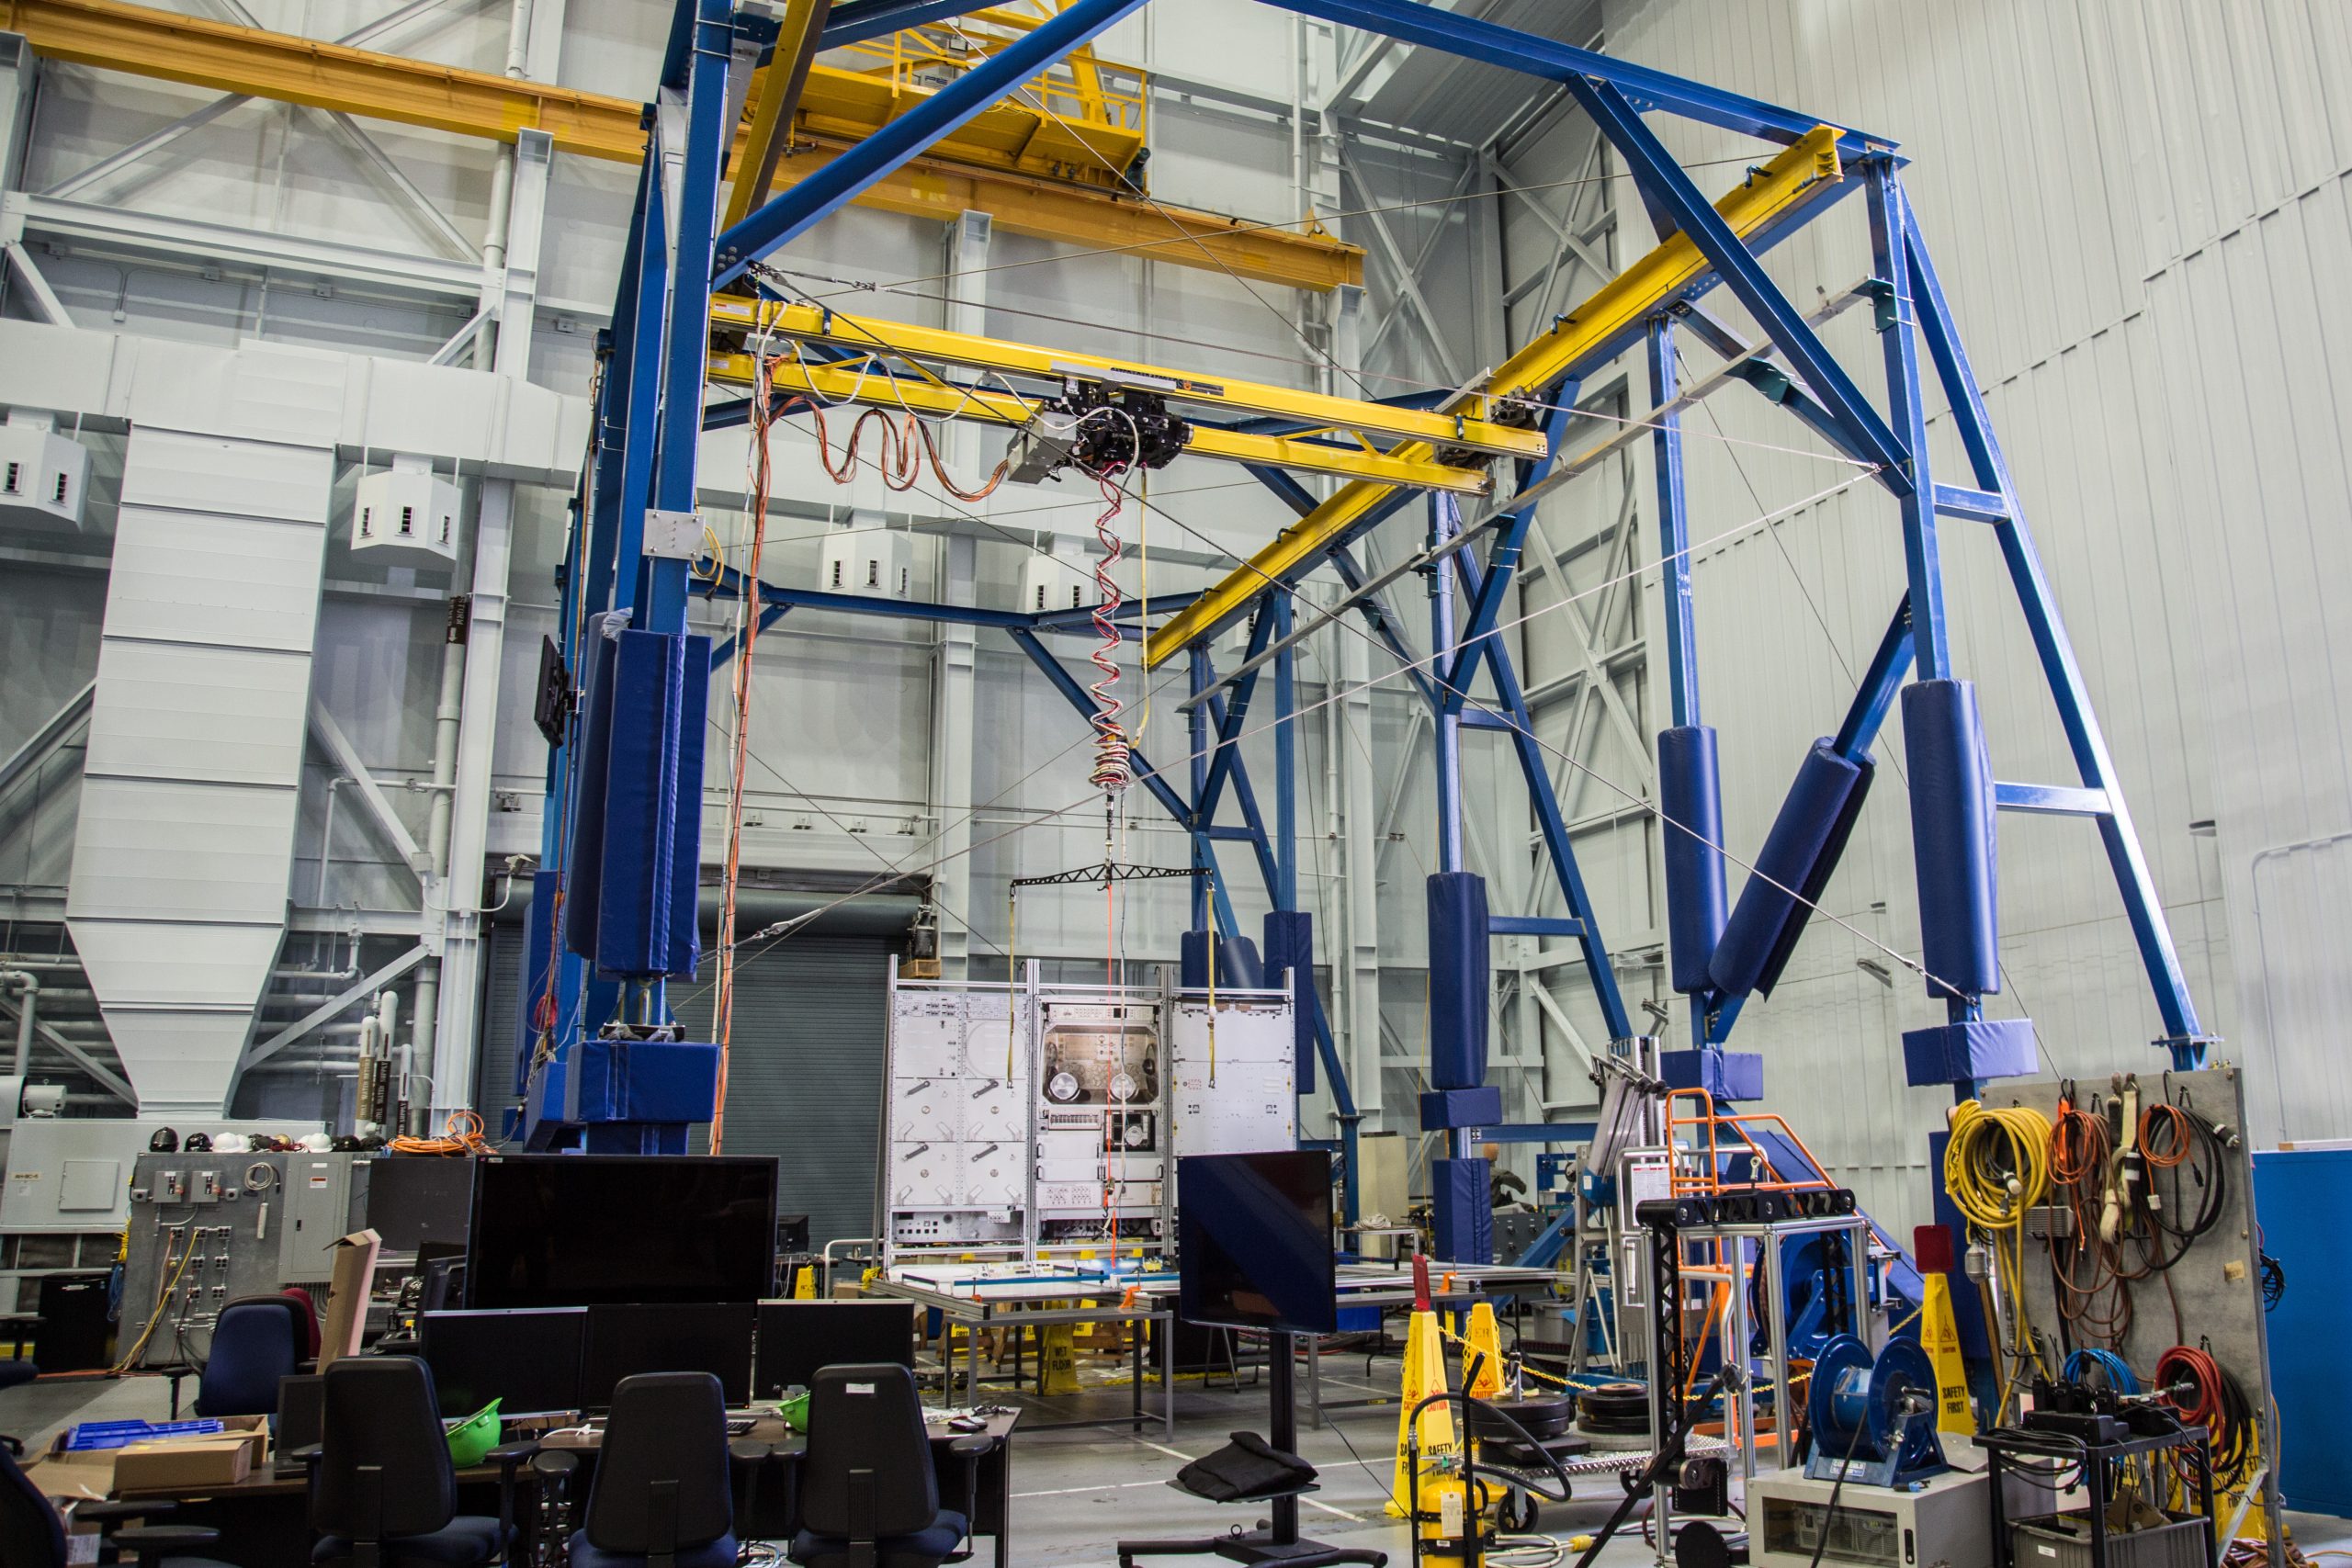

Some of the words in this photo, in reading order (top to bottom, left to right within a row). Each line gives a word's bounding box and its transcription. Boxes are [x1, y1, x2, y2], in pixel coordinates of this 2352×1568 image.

[1056, 1347, 1067, 1356] WET
[1053, 1359, 1070, 1371] FLOOR
[1942, 1387, 1964, 1399] SAFETY
[1427, 1400, 1448, 1412] CAUTION
[1947, 1402, 1963, 1414] FIRST
[1428, 1442, 1453, 1456] SAFETY
